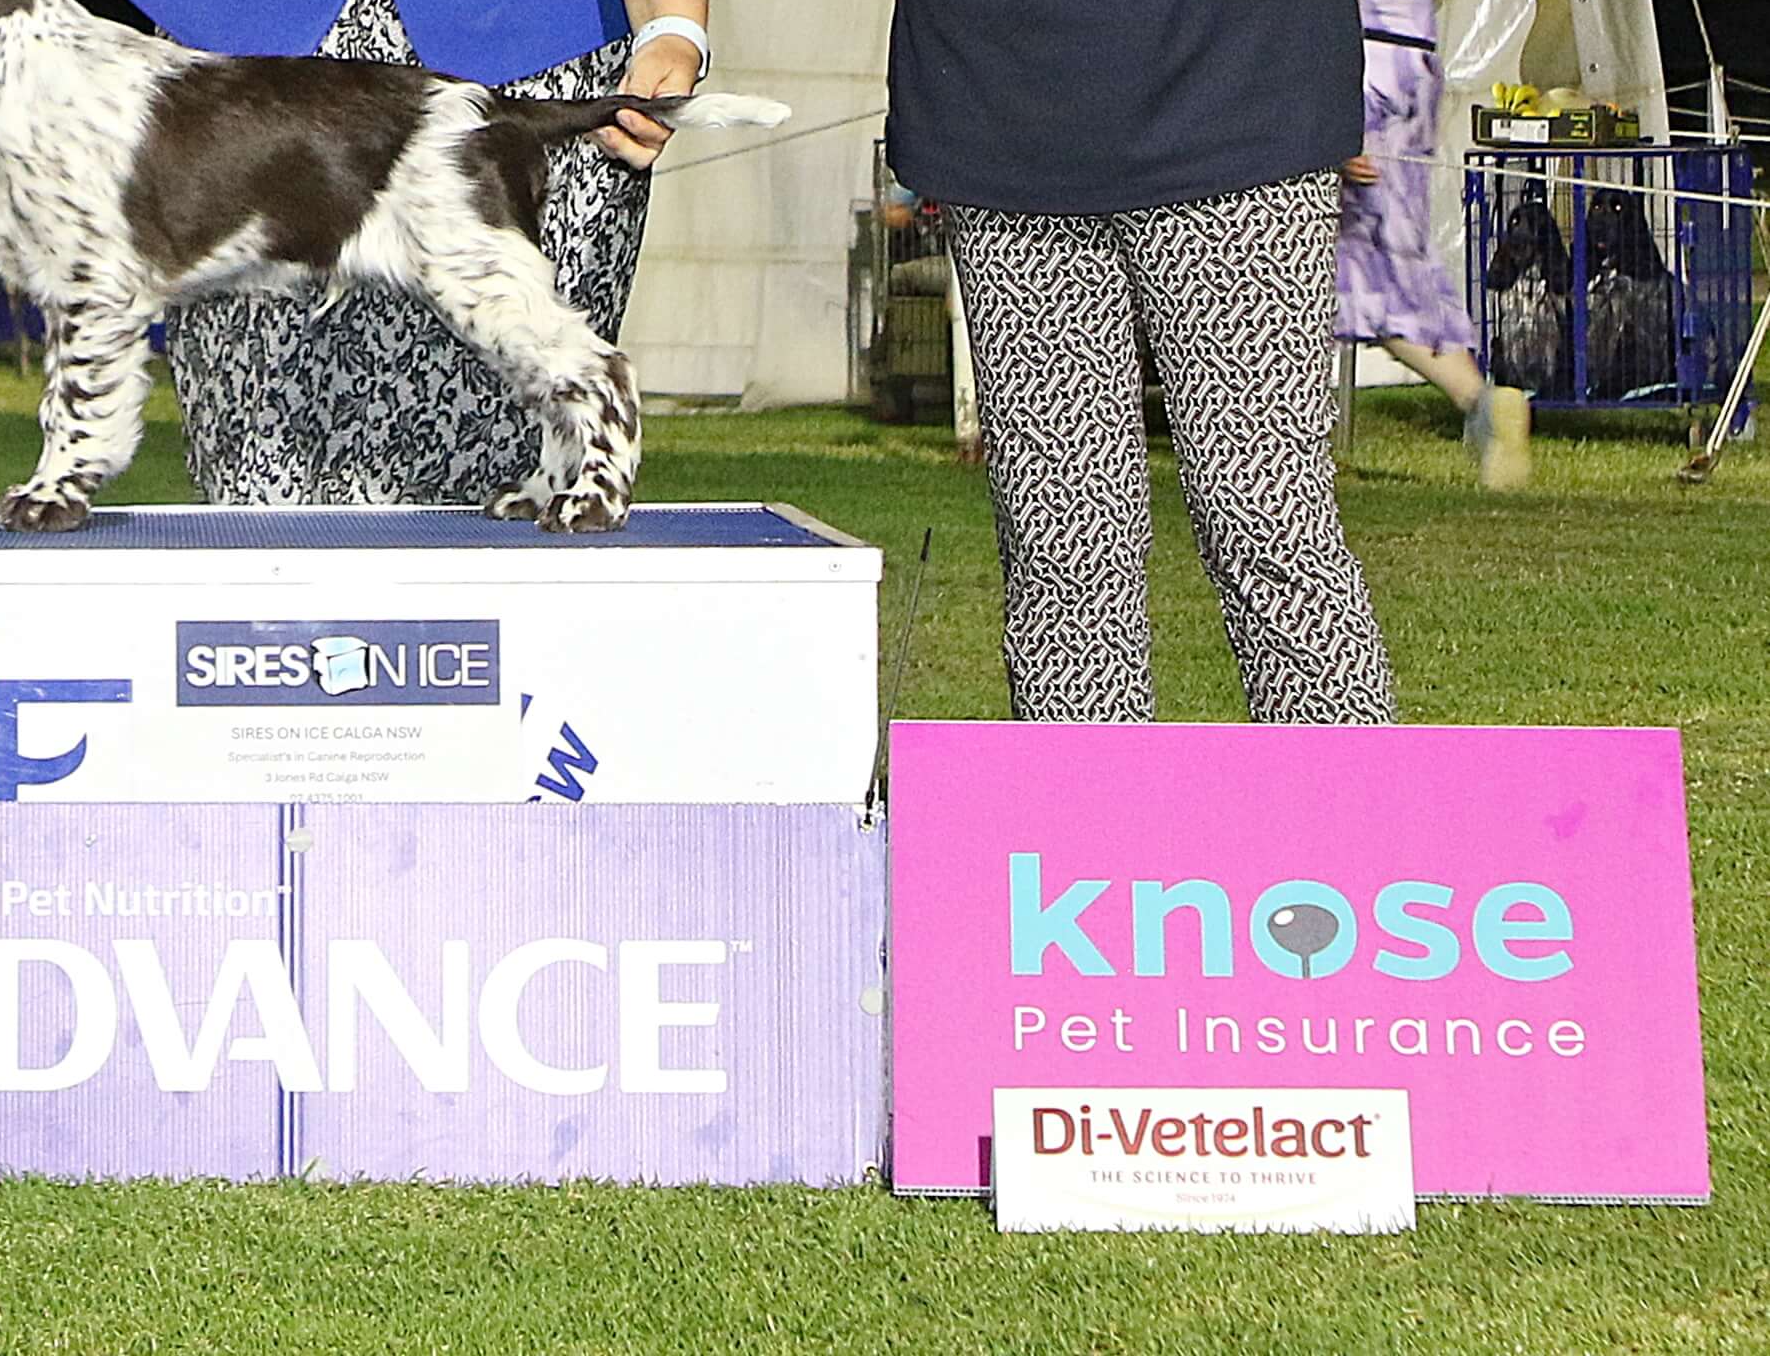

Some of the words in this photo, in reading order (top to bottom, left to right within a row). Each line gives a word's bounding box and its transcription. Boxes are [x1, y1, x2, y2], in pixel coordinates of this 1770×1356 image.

[186, 644, 311, 688] SIRES
[419, 644, 490, 688] ICE
[231, 727, 274, 740] SIRES
[277, 727, 301, 740] ON
[305, 727, 329, 739] ICE
[332, 726, 384, 740] CALGA
[386, 726, 424, 739] NSW
[307, 751, 347, 762] Canine
[349, 750, 426, 763] Reproduction
[361, 771, 390, 782] NSW
[1, 880, 71, 916] Pet
[1008, 852, 1575, 982] knose
[1013, 1005, 1134, 1053] Pet
[1176, 1007, 1587, 1057] Insurance
[1032, 1105, 1373, 1158] Di-Vetelact
[1090, 1170, 1125, 1184] THE
[1133, 1170, 1209, 1184] SCIENCE
[1219, 1171, 1242, 1185] TO
[1250, 1171, 1317, 1185] THRIVE
